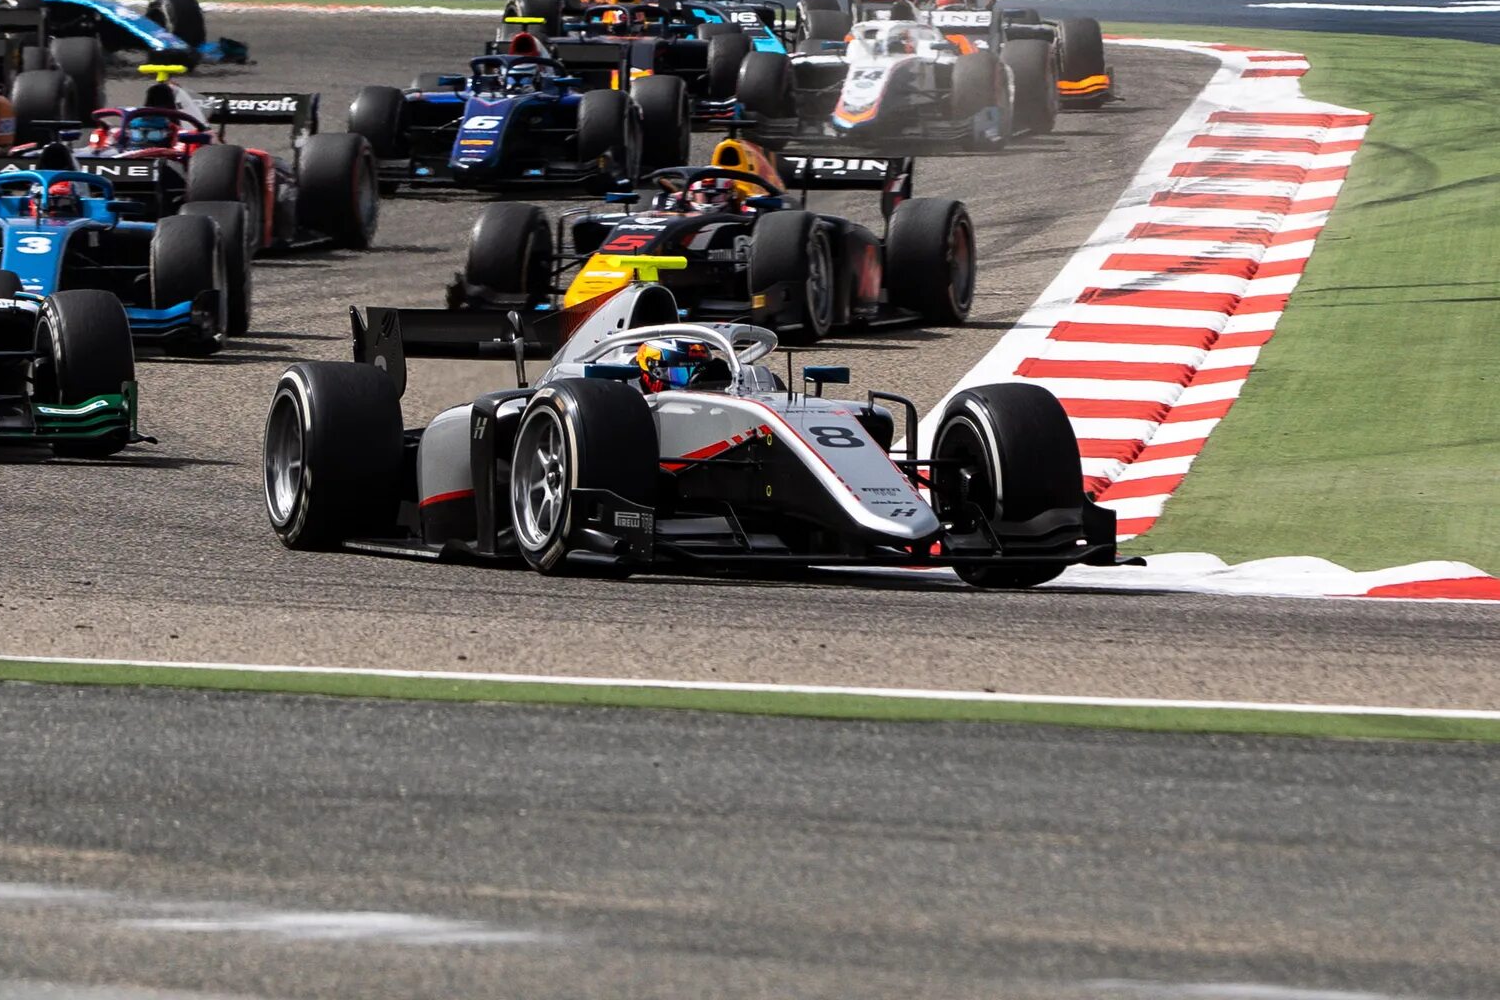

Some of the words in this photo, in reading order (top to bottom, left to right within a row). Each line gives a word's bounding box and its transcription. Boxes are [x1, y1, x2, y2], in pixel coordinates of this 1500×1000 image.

[731, 12, 757, 23] 16
[463, 116, 504, 129] 6
[16, 236, 52, 254] 3
[603, 234, 655, 251] 5
[809, 426, 865, 448] 8
